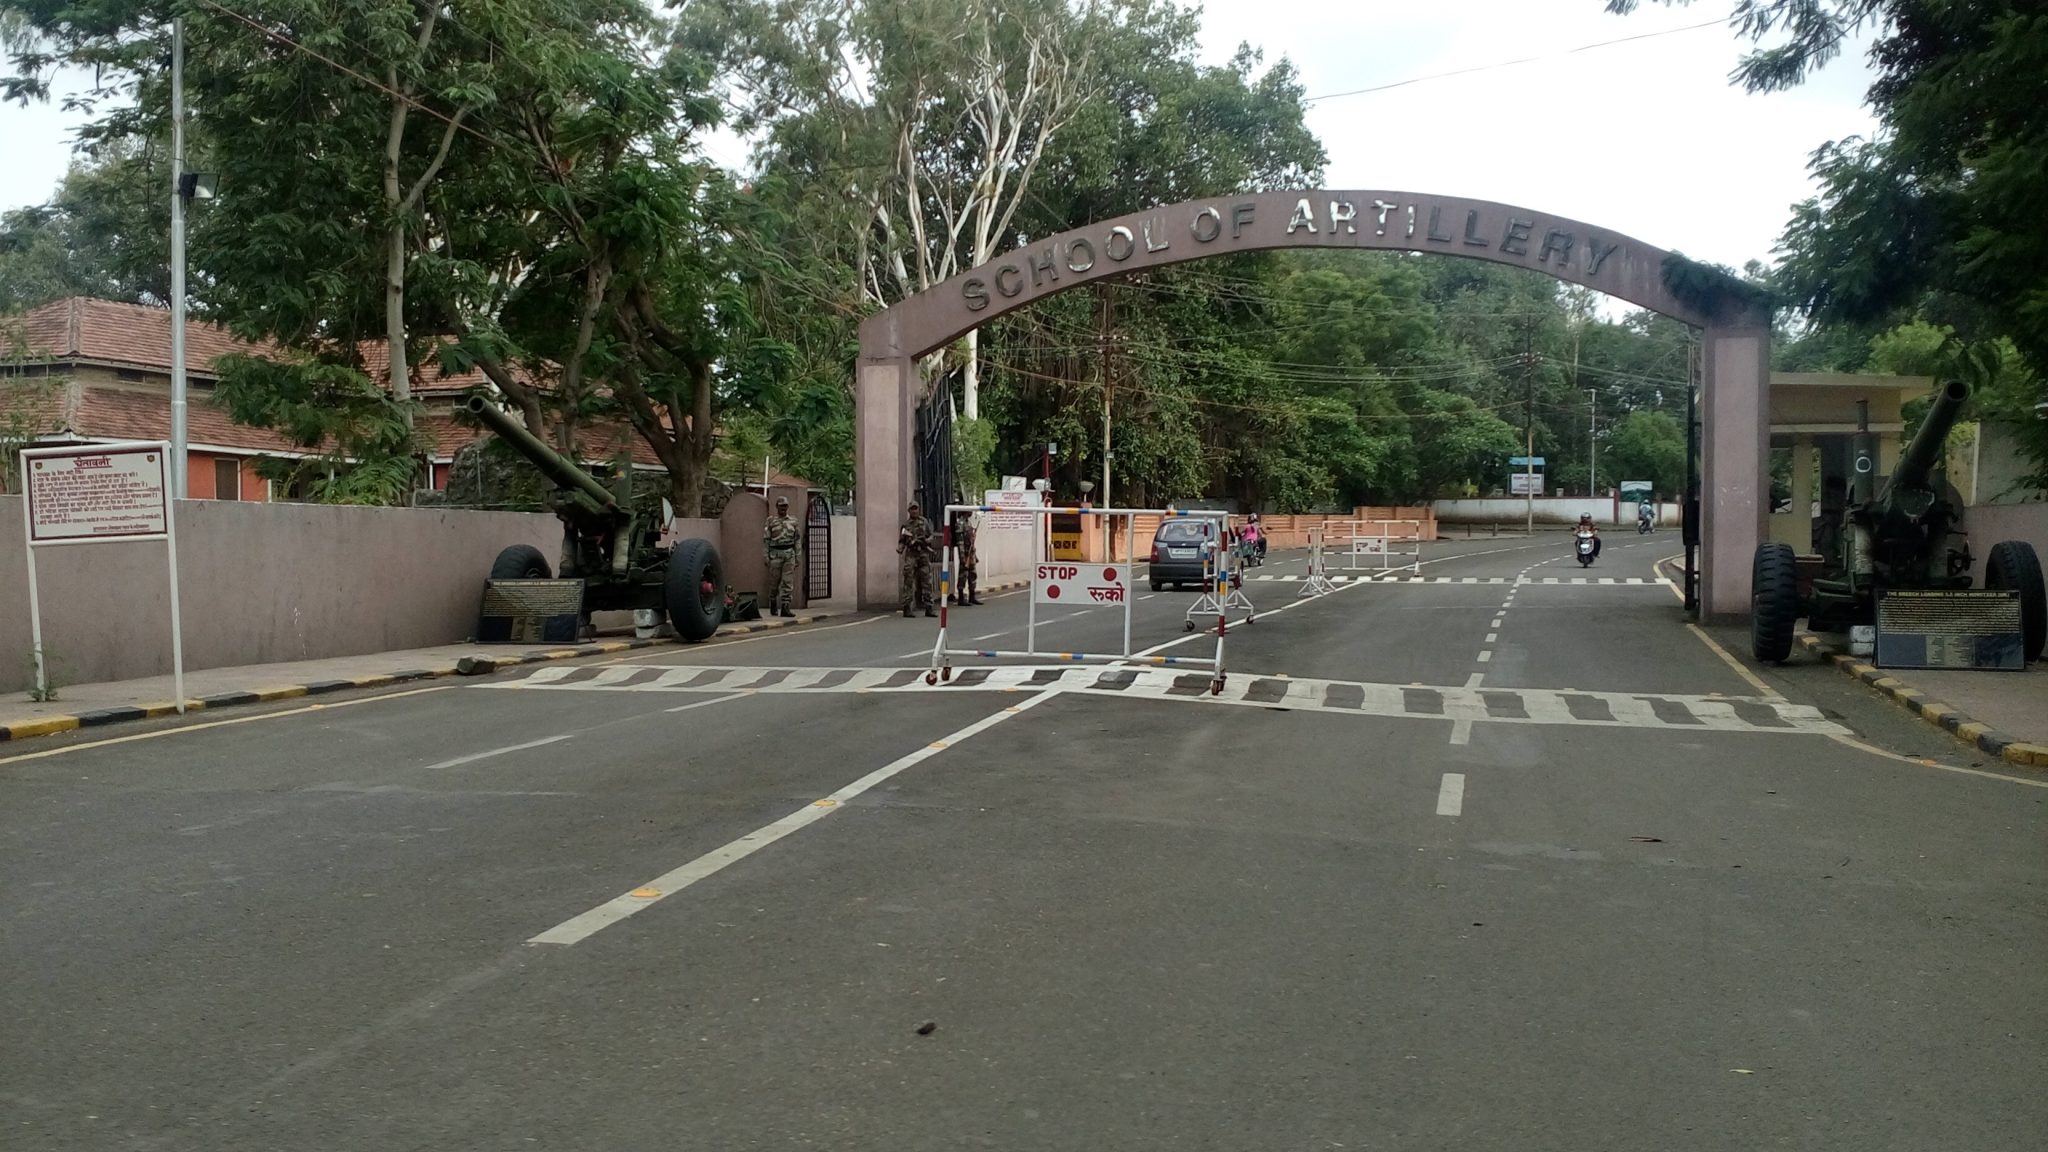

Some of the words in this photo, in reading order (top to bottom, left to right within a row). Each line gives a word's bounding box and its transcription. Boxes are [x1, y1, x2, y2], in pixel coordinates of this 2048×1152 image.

[961, 218, 1170, 311] SCHOOL
[1190, 202, 1257, 243] OF
[1286, 197, 1619, 276] ARTILLERY
[1038, 566, 1078, 580] STOP
[1087, 581, 1125, 602] रूको
